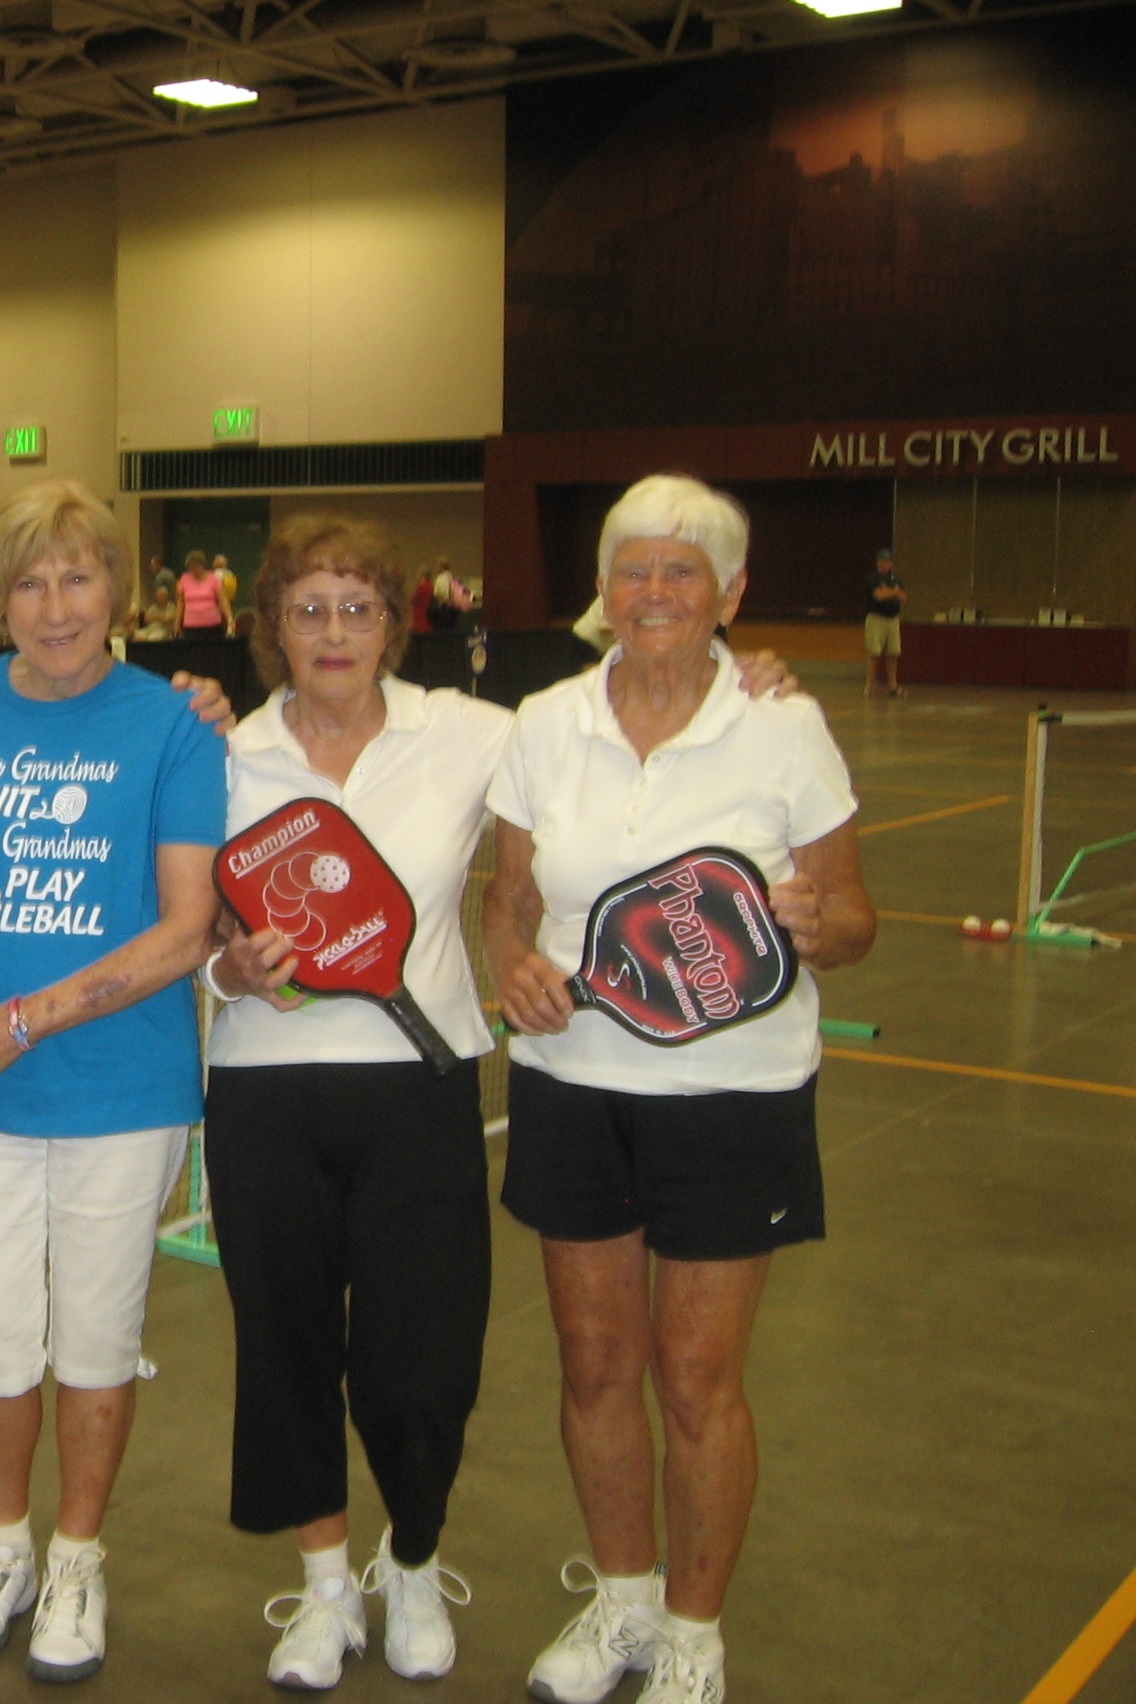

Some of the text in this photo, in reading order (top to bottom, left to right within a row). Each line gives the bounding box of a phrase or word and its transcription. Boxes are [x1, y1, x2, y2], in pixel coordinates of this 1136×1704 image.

[809, 426, 1119, 468] MILL CITY GRILL
[11, 746, 118, 785] Grandmas
[3, 820, 111, 863] Grandmas
[228, 810, 317, 873] Champion
[5, 867, 85, 901] PLAY
[648, 863, 739, 1019] Phantom
